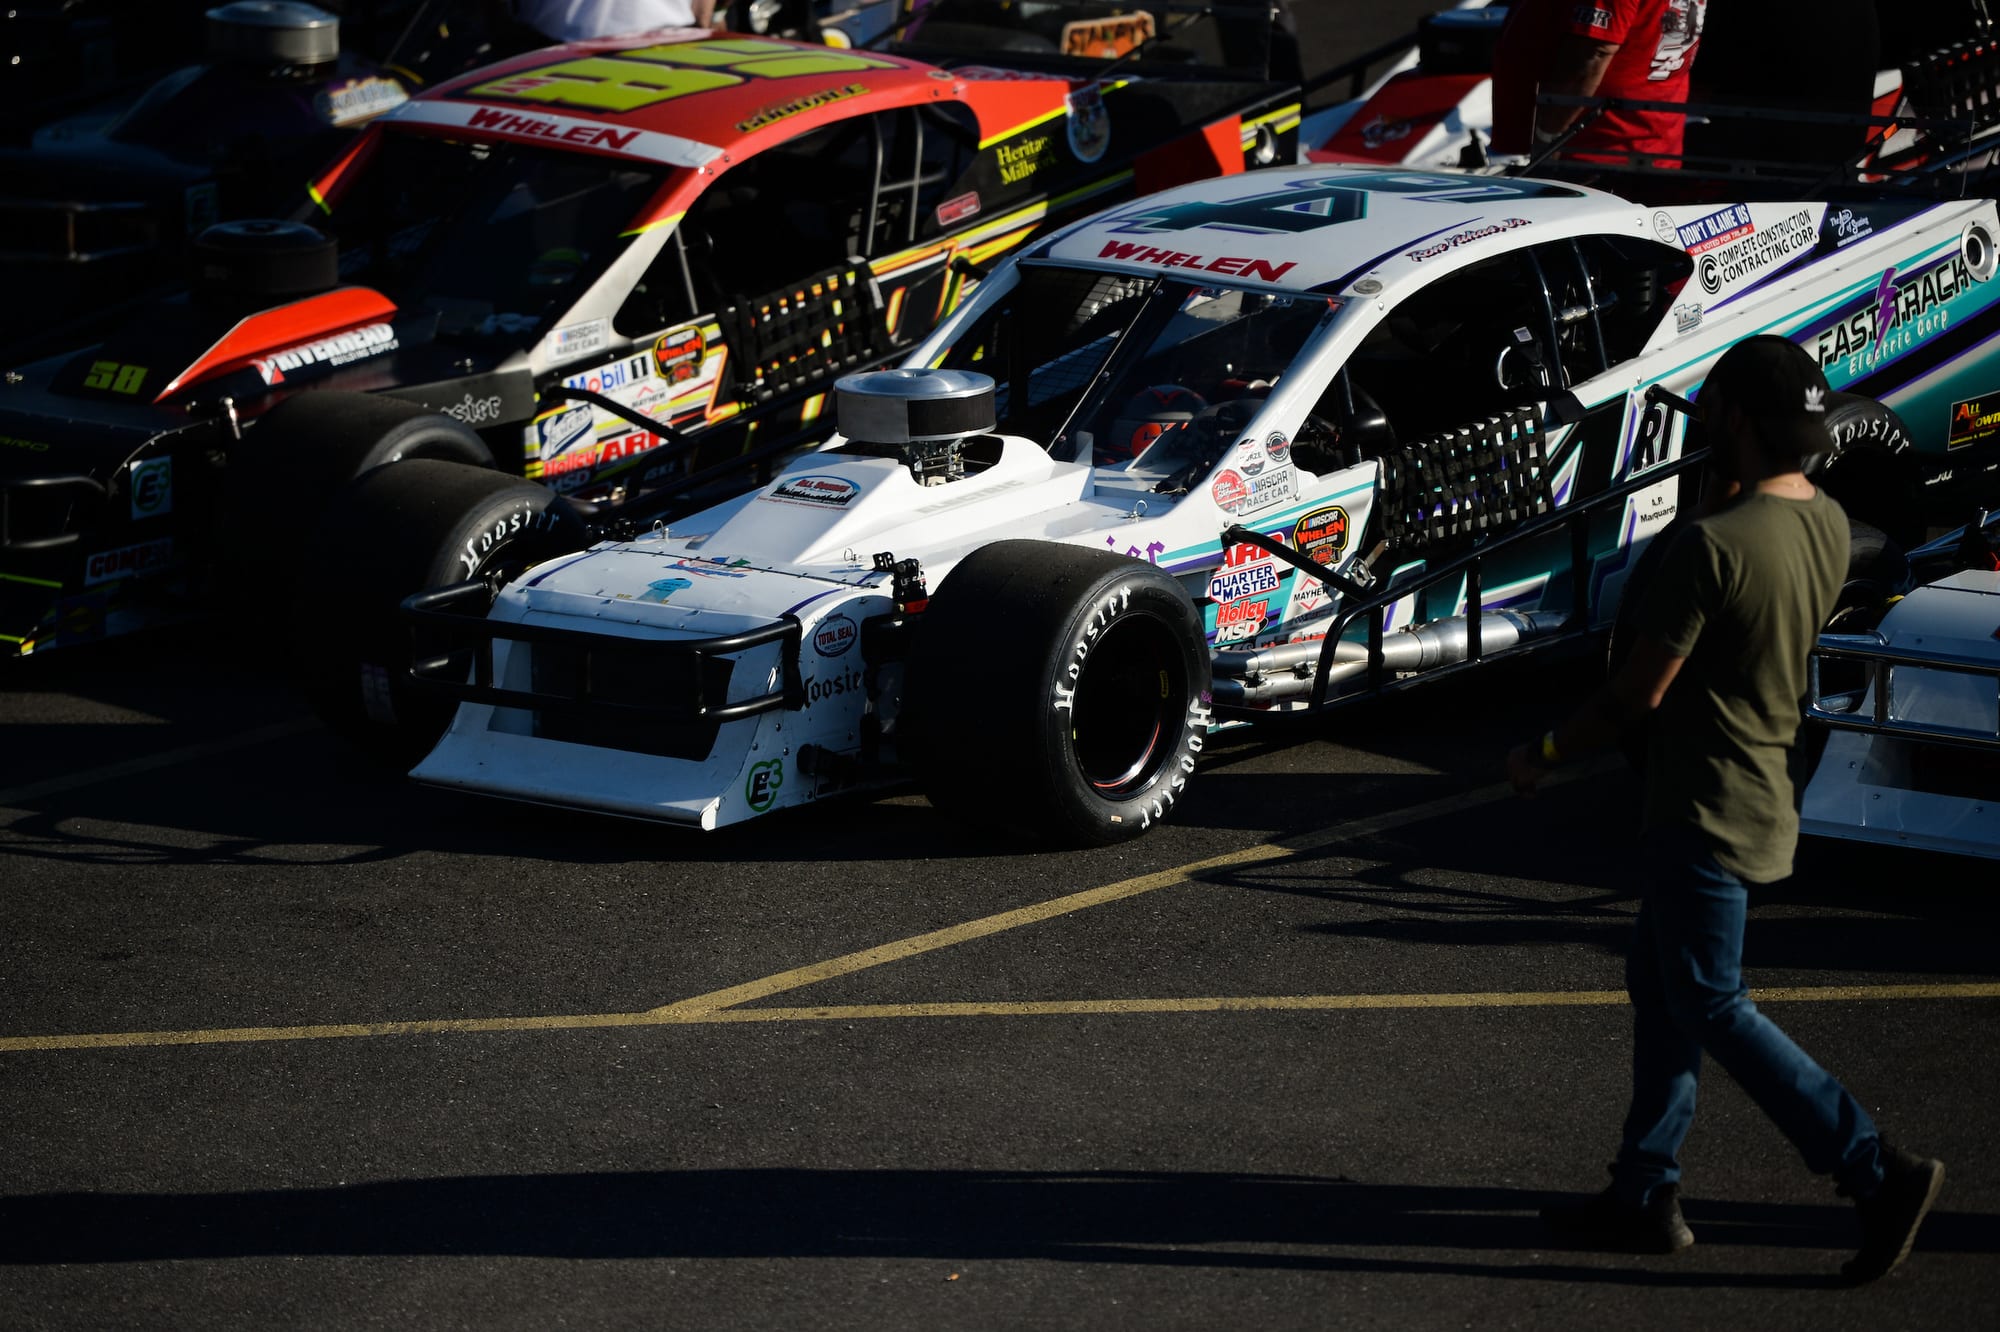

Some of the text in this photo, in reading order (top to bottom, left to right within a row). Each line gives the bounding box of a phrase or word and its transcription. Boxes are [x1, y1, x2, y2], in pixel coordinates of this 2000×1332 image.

[467, 108, 641, 150] WHELEN
[1679, 221, 1708, 247] DON'T
[1705, 209, 1738, 236] BLAME
[1735, 204, 1750, 225] US
[1718, 235, 1757, 267] COMPLETE
[1756, 208, 1812, 246] CONSTRUCTION
[1405, 242, 1448, 262] Ron
[1702, 238, 1720, 250] VOTED
[1720, 233, 1731, 243] FOR
[1722, 240, 1790, 284] CONTRACTING
[1791, 226, 1818, 252] CORP.
[1097, 239, 1298, 283] WHELEN
[1818, 256, 1970, 368] FAST TRACK
[556, 337, 600, 357] RACE CAR
[656, 336, 703, 363] WHELEN
[1848, 309, 1949, 376] Electric Corp
[82, 358, 149, 396] 58
[569, 357, 647, 394] Mobil 1
[441, 393, 502, 424] sier
[1954, 402, 1981, 422] ALL
[543, 450, 597, 478] Holley
[548, 470, 592, 492] MSD
[1254, 470, 1288, 493] NASCAR
[1247, 485, 1290, 508] RACE CAR
[1311, 511, 1338, 528] NASCAR
[1640, 505, 1676, 524] Marquardt
[460, 501, 560, 580] Hoosier
[1297, 518, 1345, 545] WHELEN
[1212, 565, 1273, 595] QUARTER
[1223, 576, 1277, 602] MASTER
[1217, 599, 1269, 624] Holley
[817, 625, 854, 647] TOTAL SEAL
[1214, 621, 1262, 644] MSD
[1053, 585, 1131, 717] Hoosier
[1140, 695, 1217, 830] Hoosier
